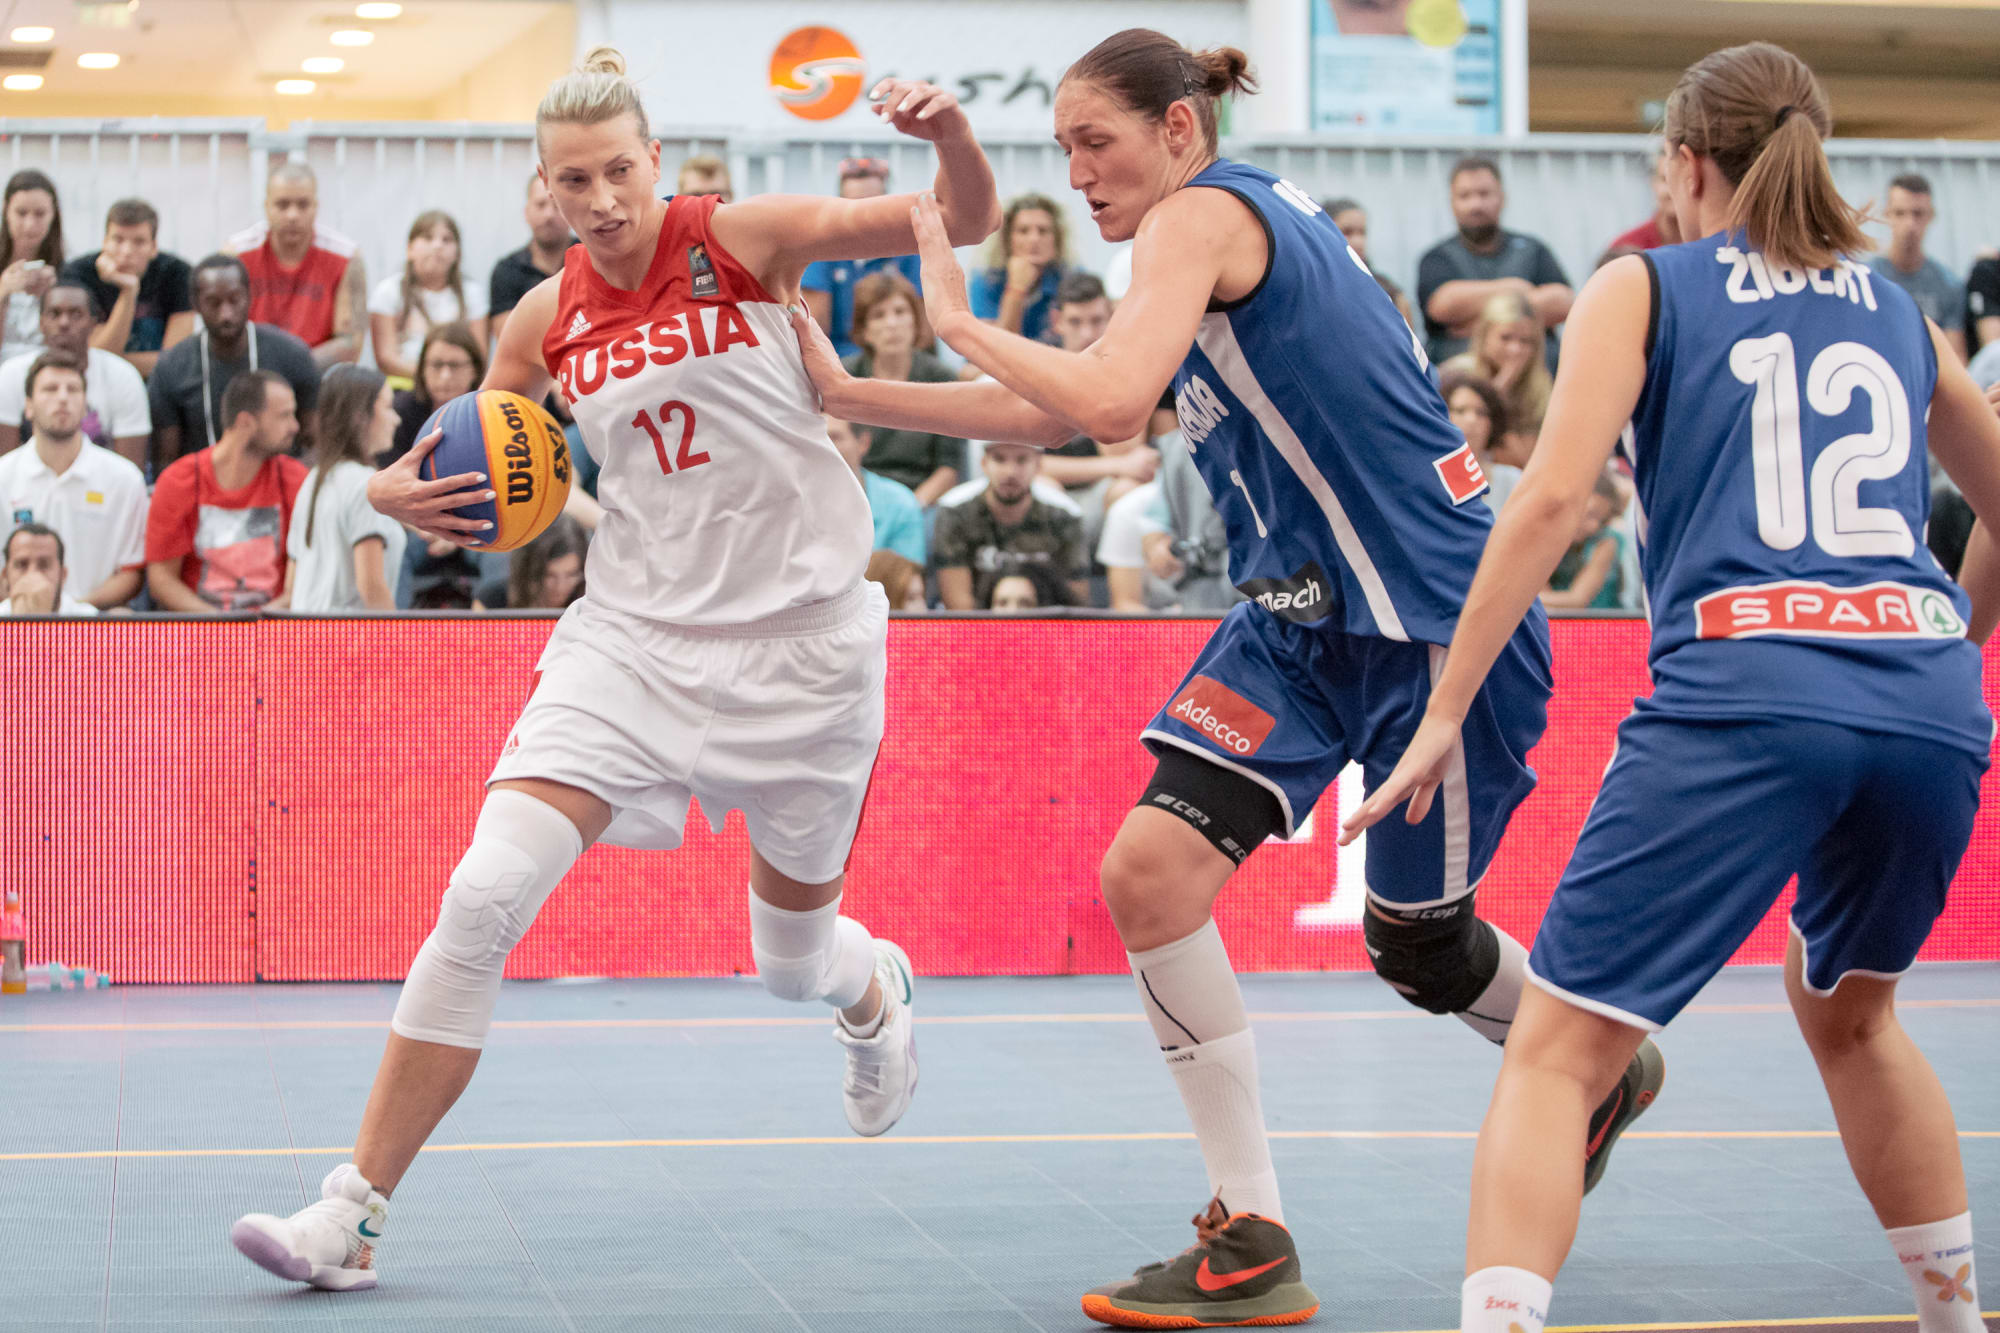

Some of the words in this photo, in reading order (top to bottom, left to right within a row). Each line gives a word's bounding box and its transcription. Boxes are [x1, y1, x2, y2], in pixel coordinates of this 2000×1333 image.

[695, 273, 714, 287] FIBA
[560, 305, 760, 405] RUSSIA
[498, 402, 534, 506] Wilson
[631, 400, 711, 476] 12
[1729, 332, 1915, 558] 12
[1730, 593, 1912, 627] SPAR
[1175, 697, 1251, 753] Adecco
